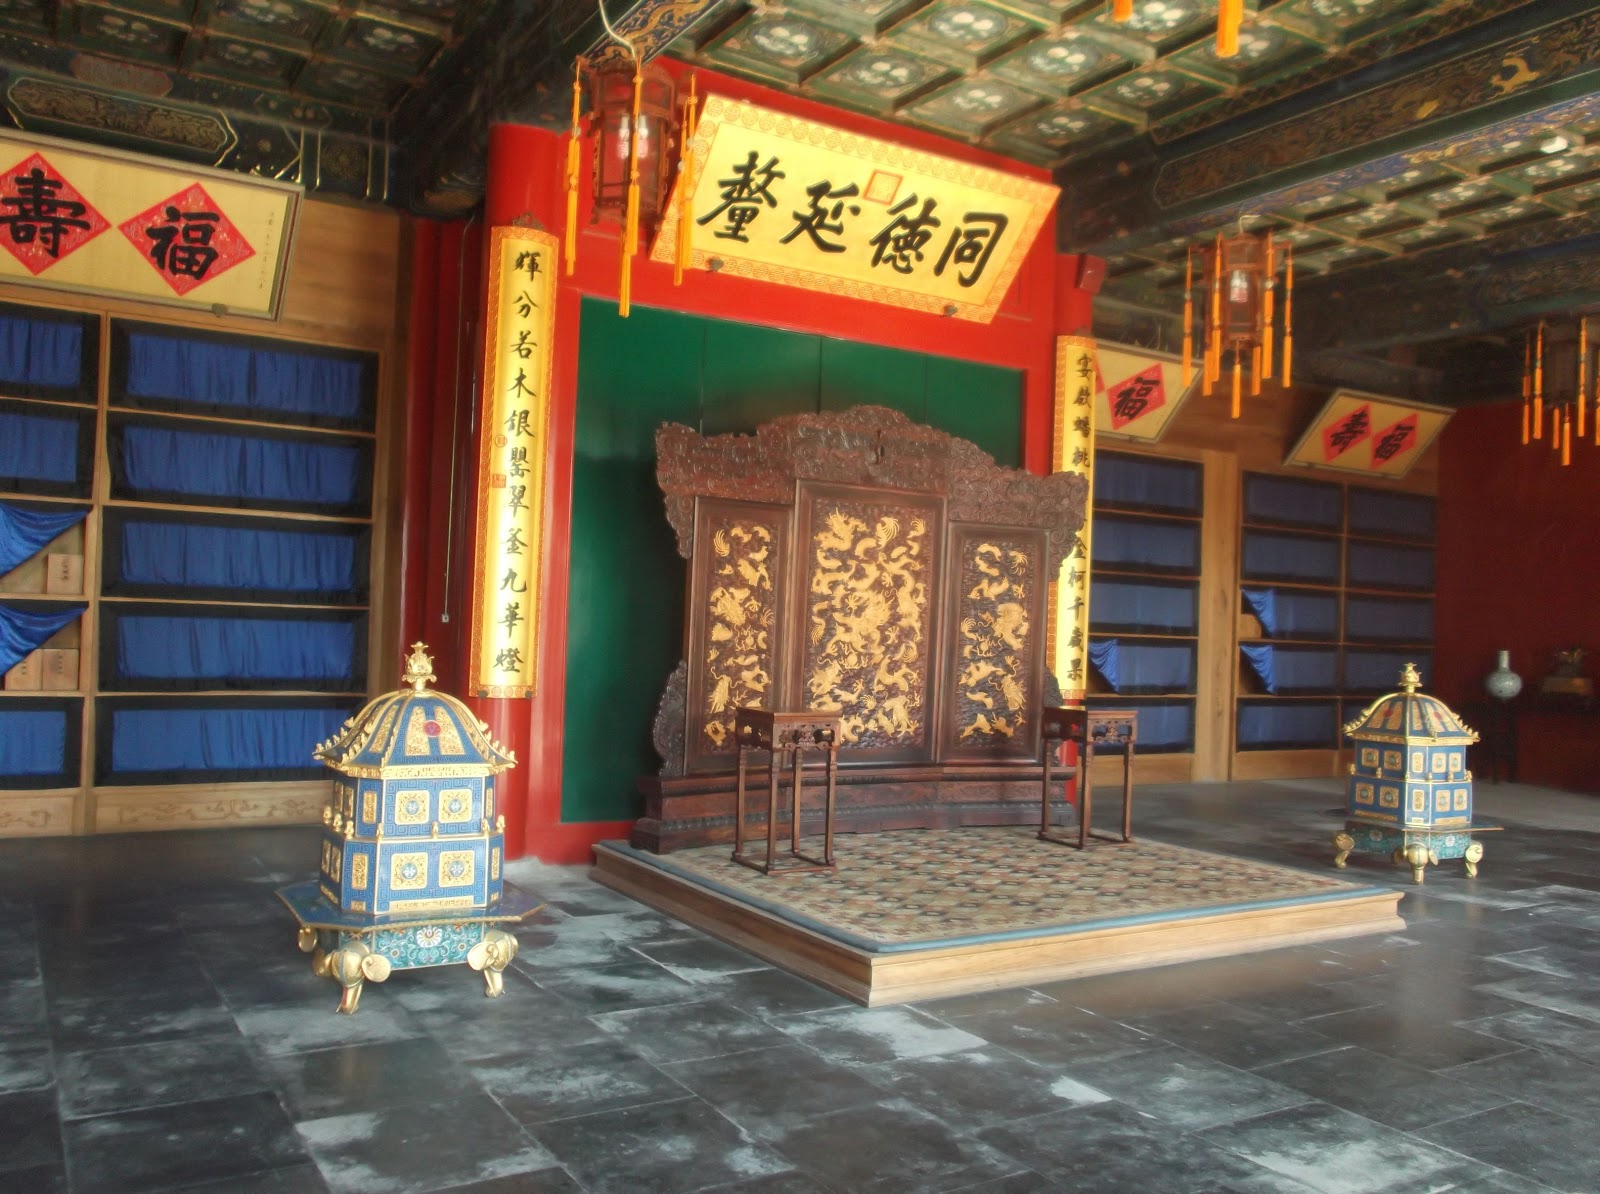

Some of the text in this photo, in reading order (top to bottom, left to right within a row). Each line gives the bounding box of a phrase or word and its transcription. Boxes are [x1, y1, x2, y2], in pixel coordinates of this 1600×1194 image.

[0, 168, 91, 258] 壽
[146, 206, 220, 280] 福
[1114, 376, 1161, 420] 福
[1330, 409, 1369, 454] 壽
[1375, 423, 1415, 460] 福
